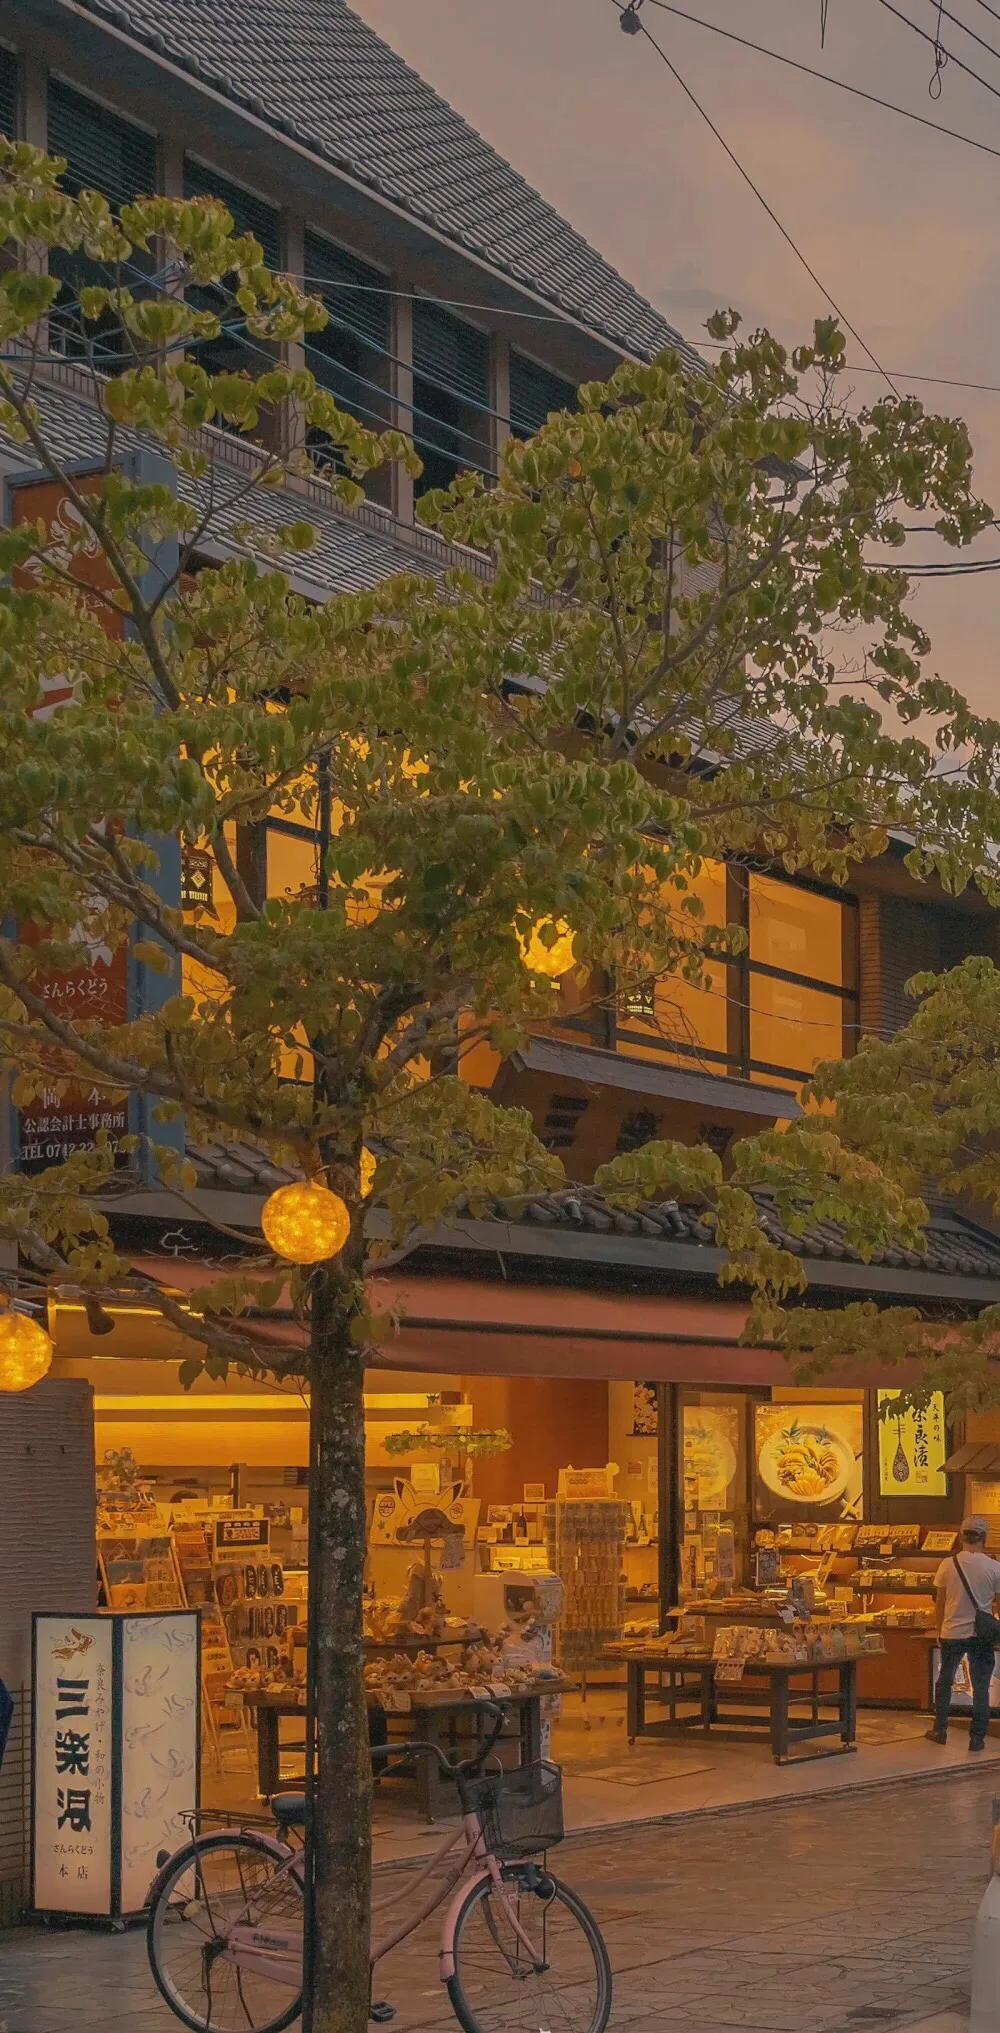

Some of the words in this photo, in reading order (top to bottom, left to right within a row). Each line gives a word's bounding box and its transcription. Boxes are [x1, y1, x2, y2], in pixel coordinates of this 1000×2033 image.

[25, 1112, 125, 1133] 公認会計士事務所
[22, 1145, 44, 1160] TEL
[55, 1678, 92, 1832] 三楽洞
[53, 1844, 94, 1856] さんらくどう
